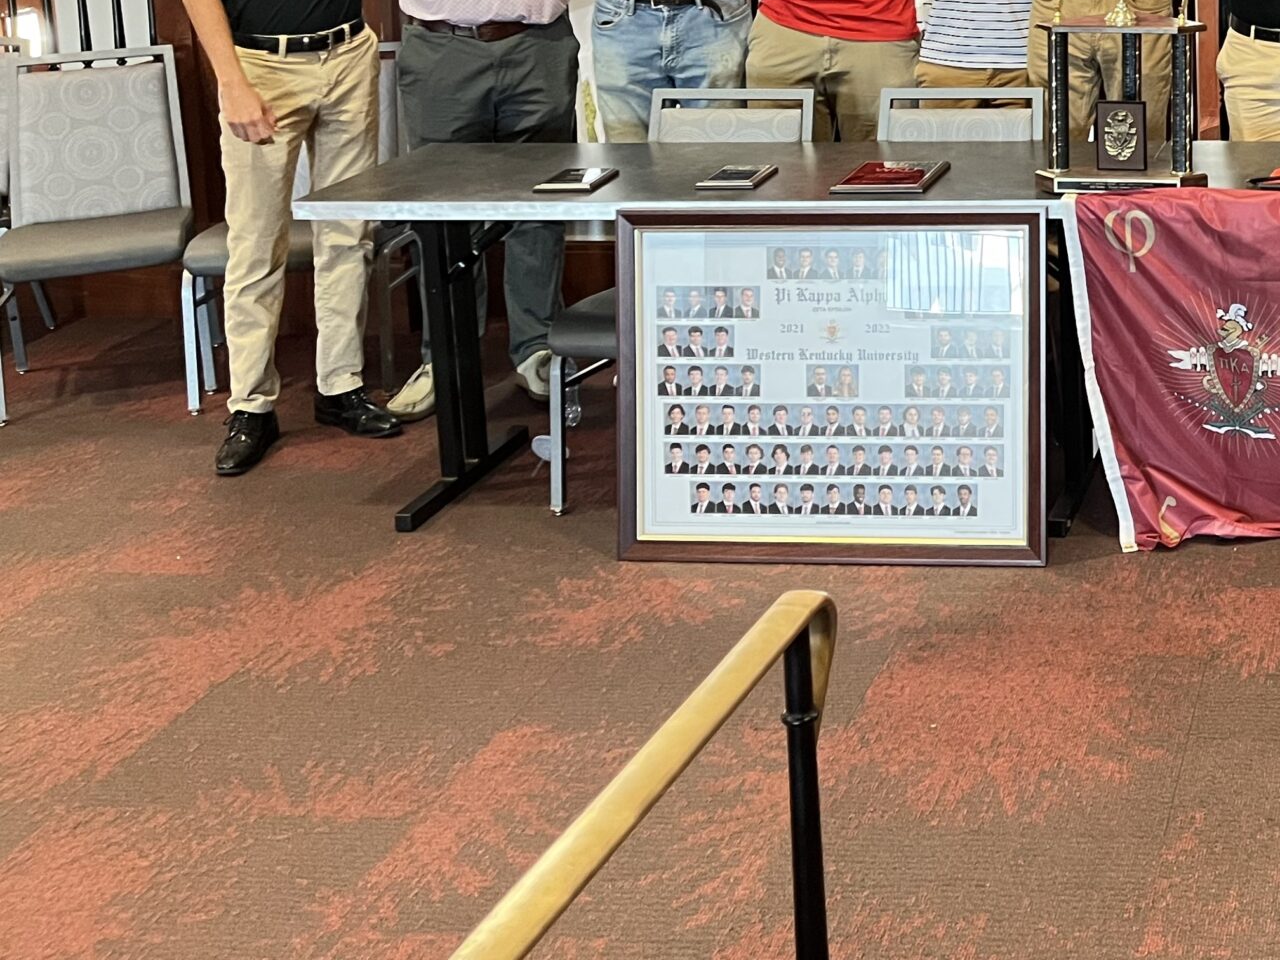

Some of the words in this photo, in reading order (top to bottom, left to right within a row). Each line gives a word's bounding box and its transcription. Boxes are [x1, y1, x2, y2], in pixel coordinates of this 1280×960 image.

[775, 287, 791, 305] Pi
[796, 287, 842, 305] Kappa
[779, 323, 805, 334] 2021
[864, 323, 891, 334] 2022
[746, 347, 795, 361] Western
[798, 347, 853, 364] Kentucky
[857, 348, 920, 364] University
